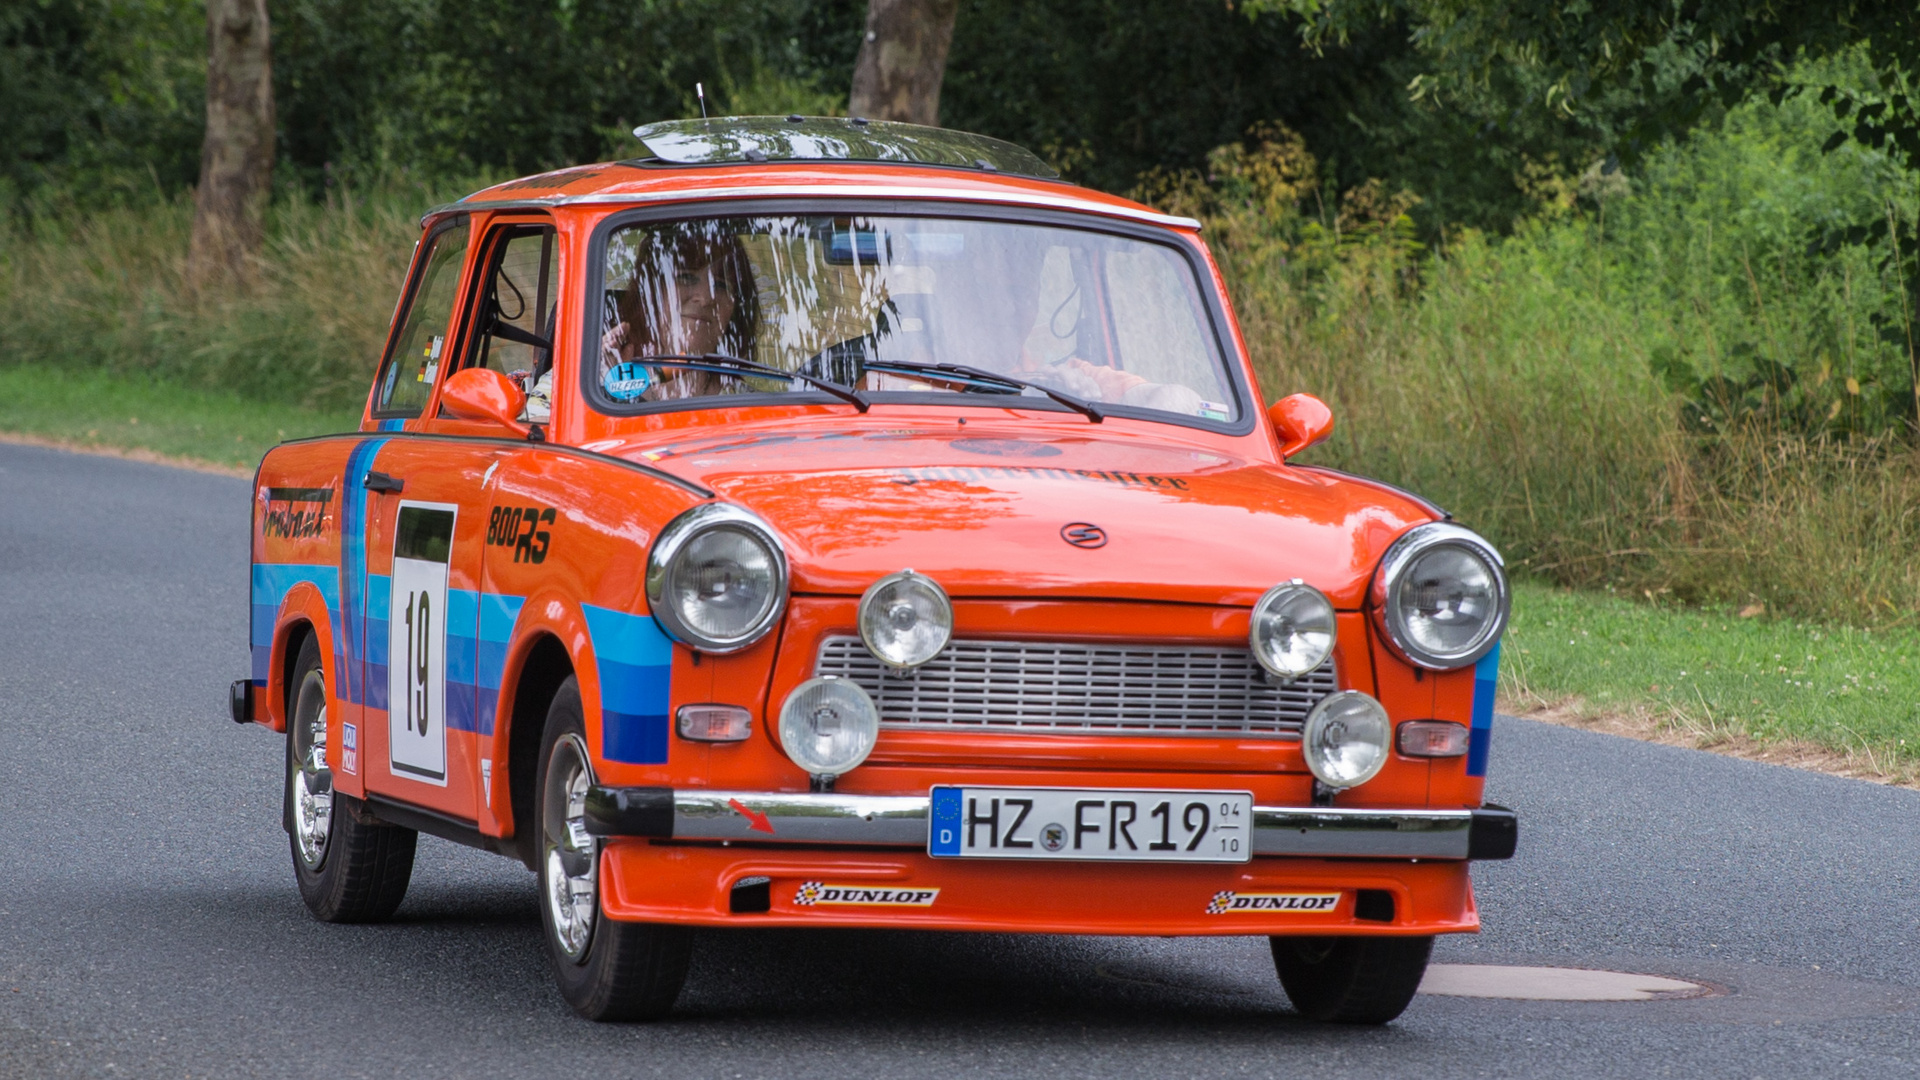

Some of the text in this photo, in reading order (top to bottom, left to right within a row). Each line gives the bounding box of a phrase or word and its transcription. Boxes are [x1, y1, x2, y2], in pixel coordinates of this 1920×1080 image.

[617, 364, 635, 382] H
[405, 590, 430, 737] 19
[1220, 803, 1240, 816] 04
[967, 798, 1034, 849] HZ
[940, 830, 952, 844] D
[1221, 838, 1239, 852] 10
[820, 889, 933, 903] DUNLOP
[1231, 897, 1336, 909] DUNLOP
